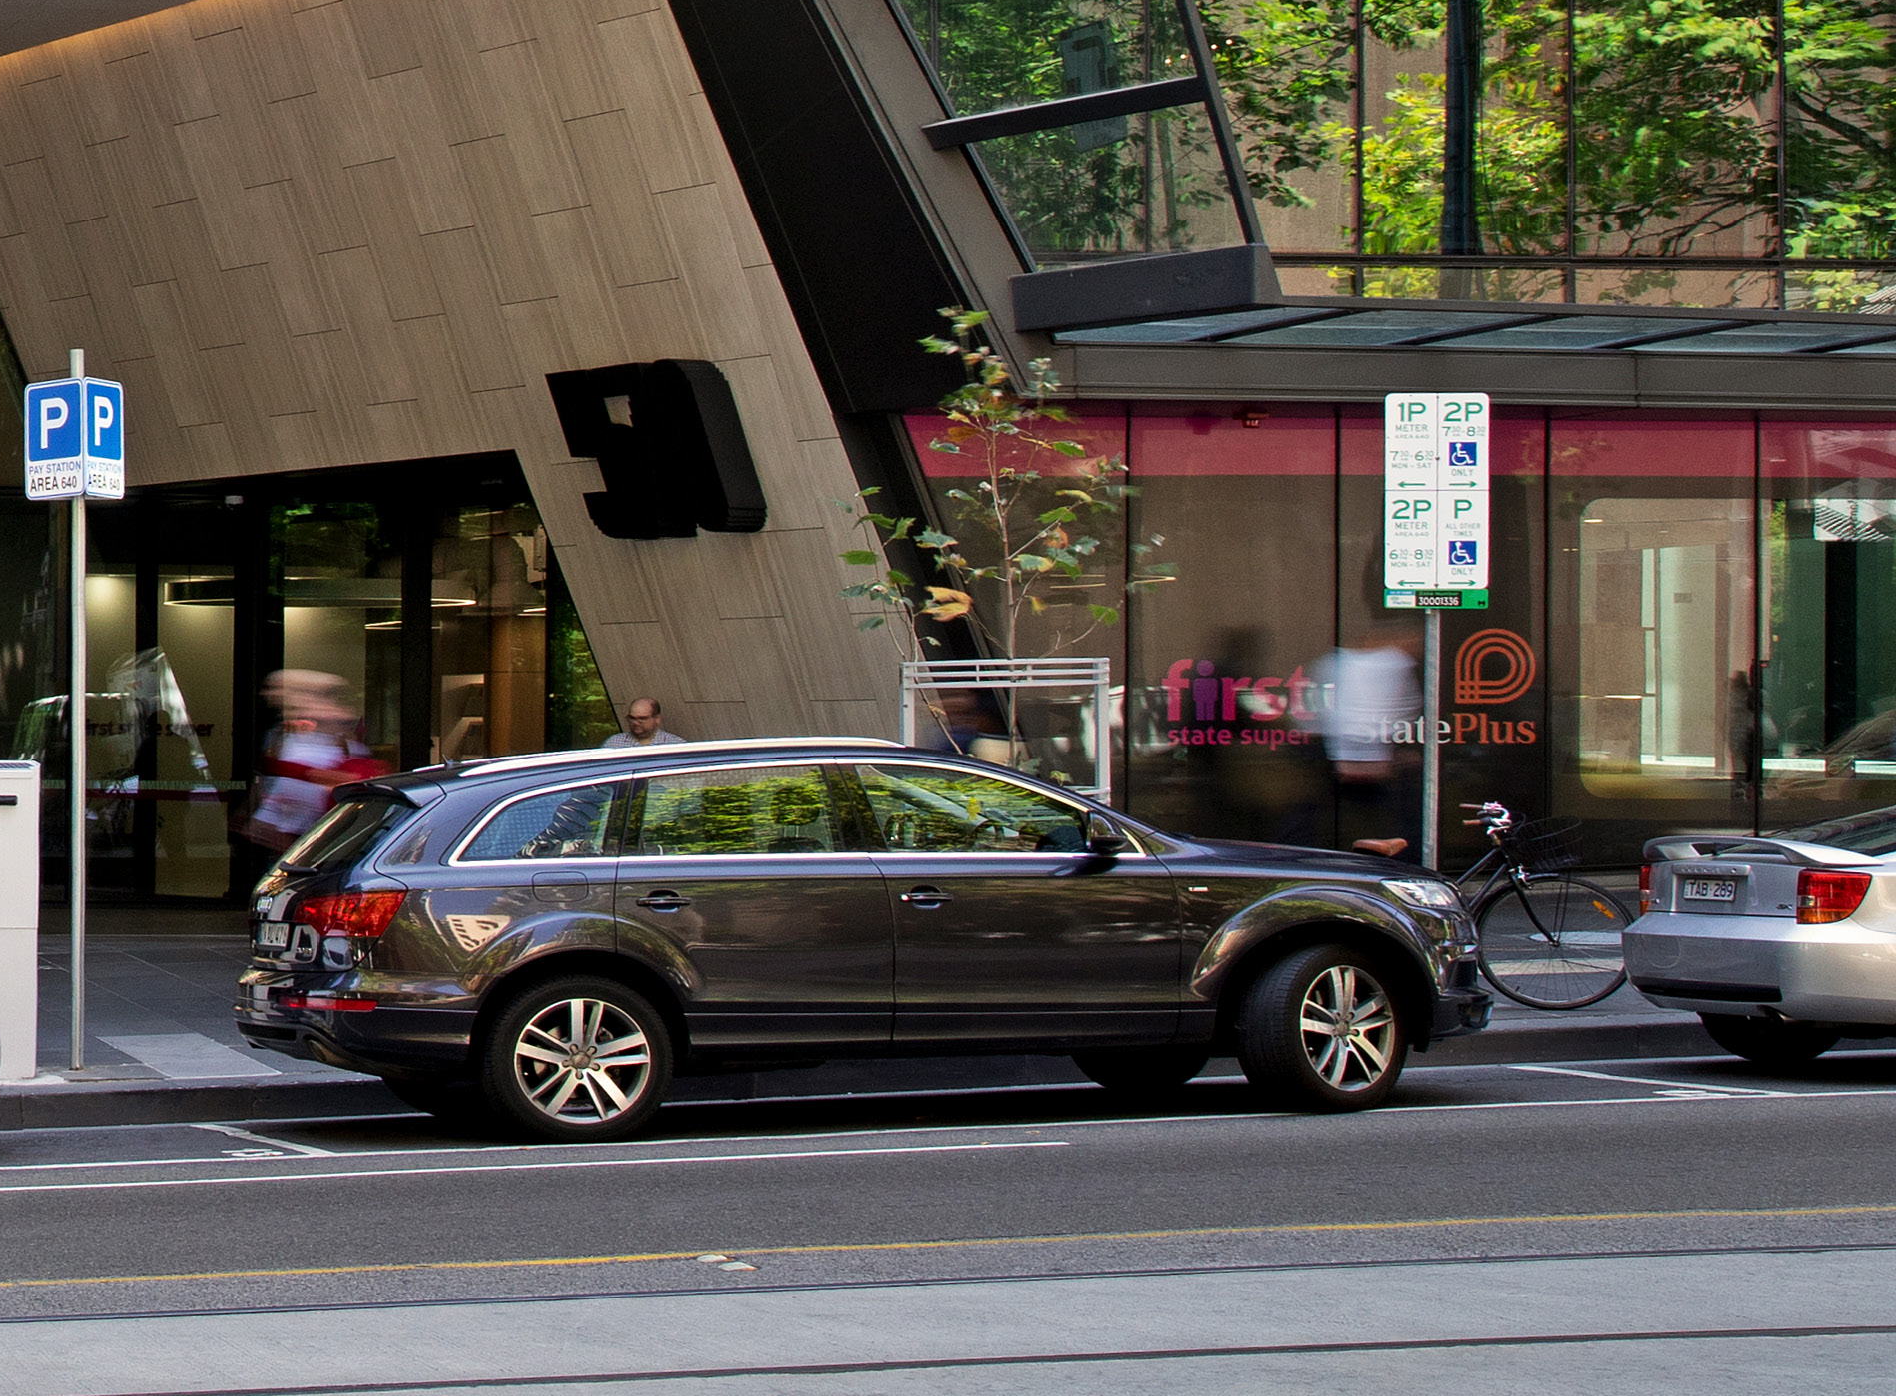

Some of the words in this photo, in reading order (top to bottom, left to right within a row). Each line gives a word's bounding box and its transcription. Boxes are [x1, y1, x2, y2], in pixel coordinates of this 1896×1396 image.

[93, 395, 114, 446] P
[1397, 401, 1427, 422] 1P
[1443, 401, 1483, 422] 2P
[40, 397, 69, 449] P
[1395, 424, 1428, 432] METER
[29, 465, 43, 475] PAY
[46, 460, 81, 474] STATION
[1451, 468, 1474, 476] ONLY
[30, 476, 59, 493] AREA
[61, 475, 78, 489] 640
[1392, 499, 1432, 519] 2P
[1453, 499, 1473, 519] P
[1395, 521, 1428, 530] METER
[1451, 567, 1473, 575] ONLY
[1418, 596, 1459, 606] 30001336
[1161, 658, 1319, 722] first
[1167, 725, 1233, 746] state
[1240, 727, 1312, 750] super
